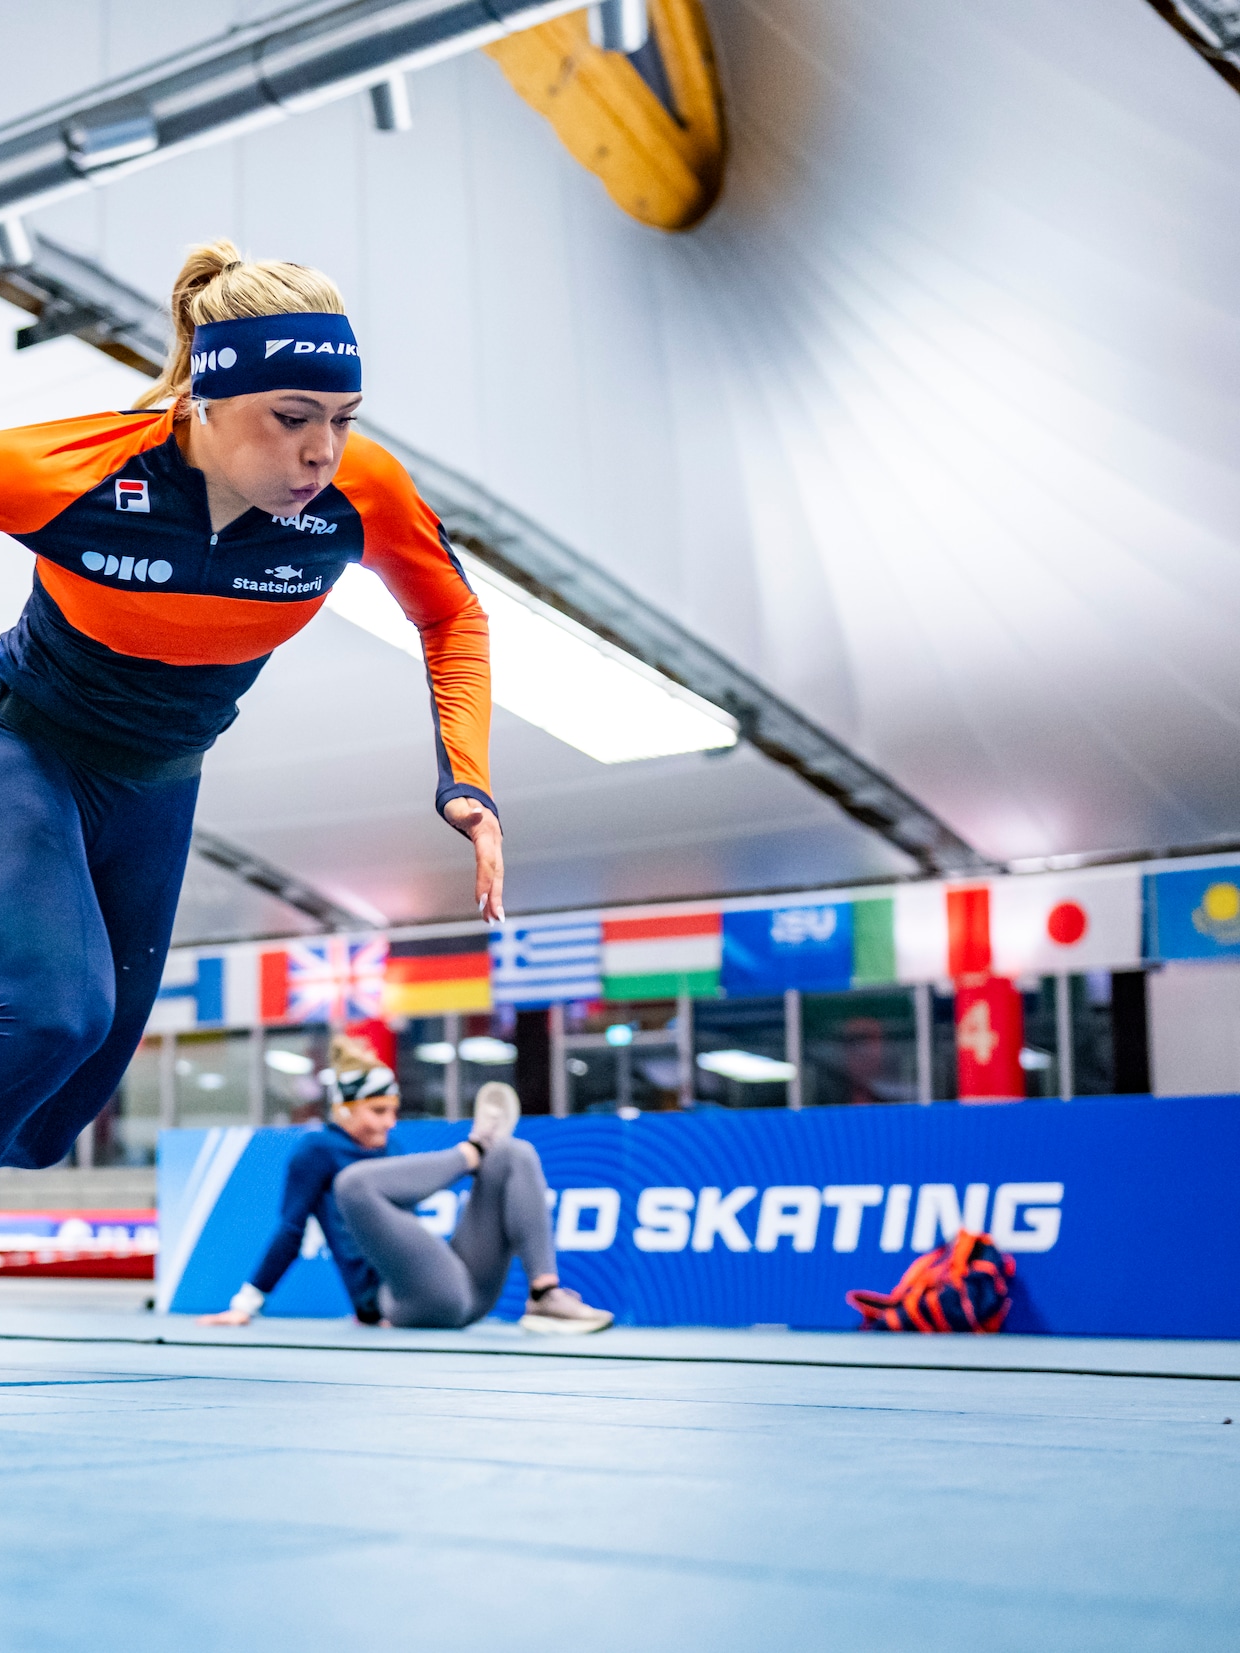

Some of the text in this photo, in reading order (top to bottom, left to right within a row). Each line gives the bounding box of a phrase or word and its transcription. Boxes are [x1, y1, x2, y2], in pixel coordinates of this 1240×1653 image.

[232, 576, 323, 594] Staatsloterij
[957, 999, 1000, 1066] 4
[632, 1181, 1065, 1254] SKATING
